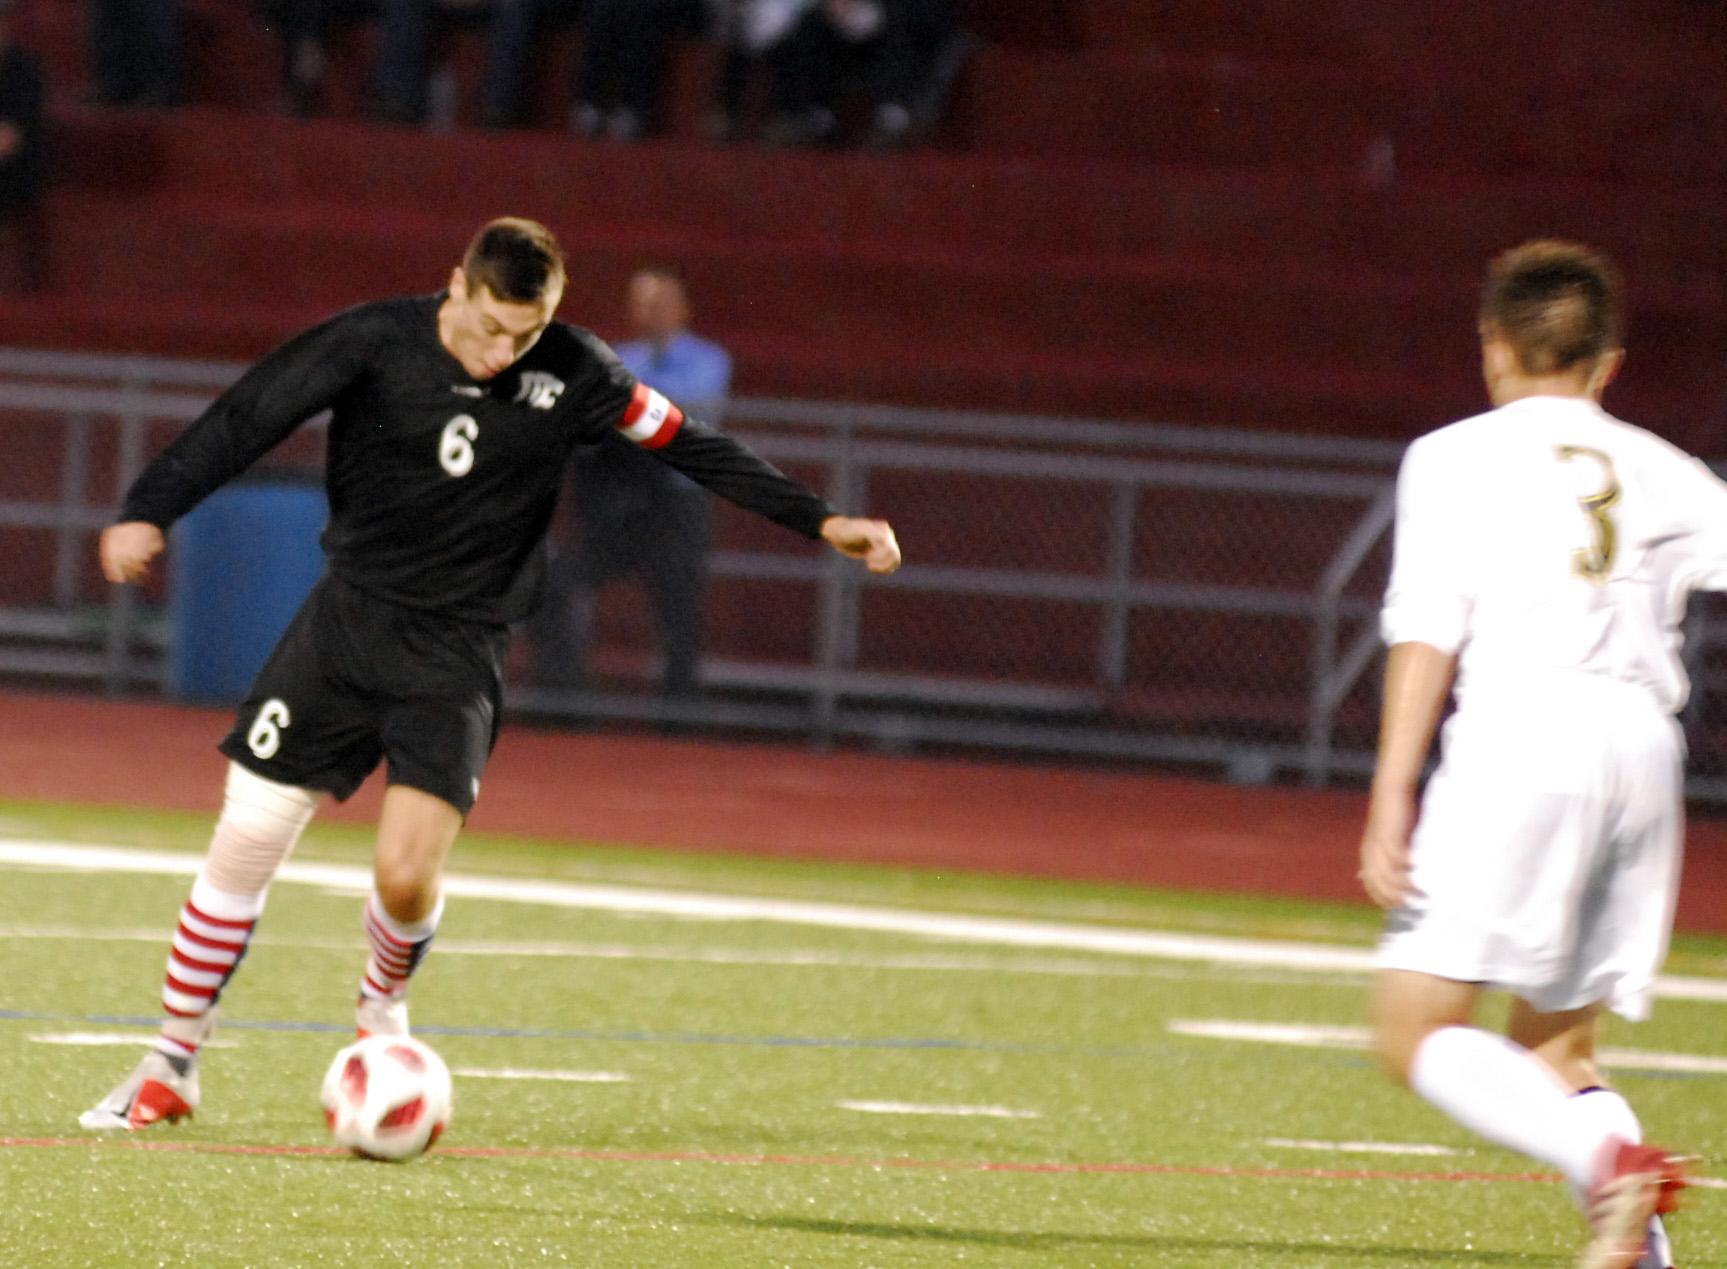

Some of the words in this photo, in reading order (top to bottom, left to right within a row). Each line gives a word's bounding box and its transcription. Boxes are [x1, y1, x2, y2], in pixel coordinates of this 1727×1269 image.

[439, 414, 479, 477] 6
[1553, 445, 1622, 582] 3
[248, 698, 290, 759] 6
